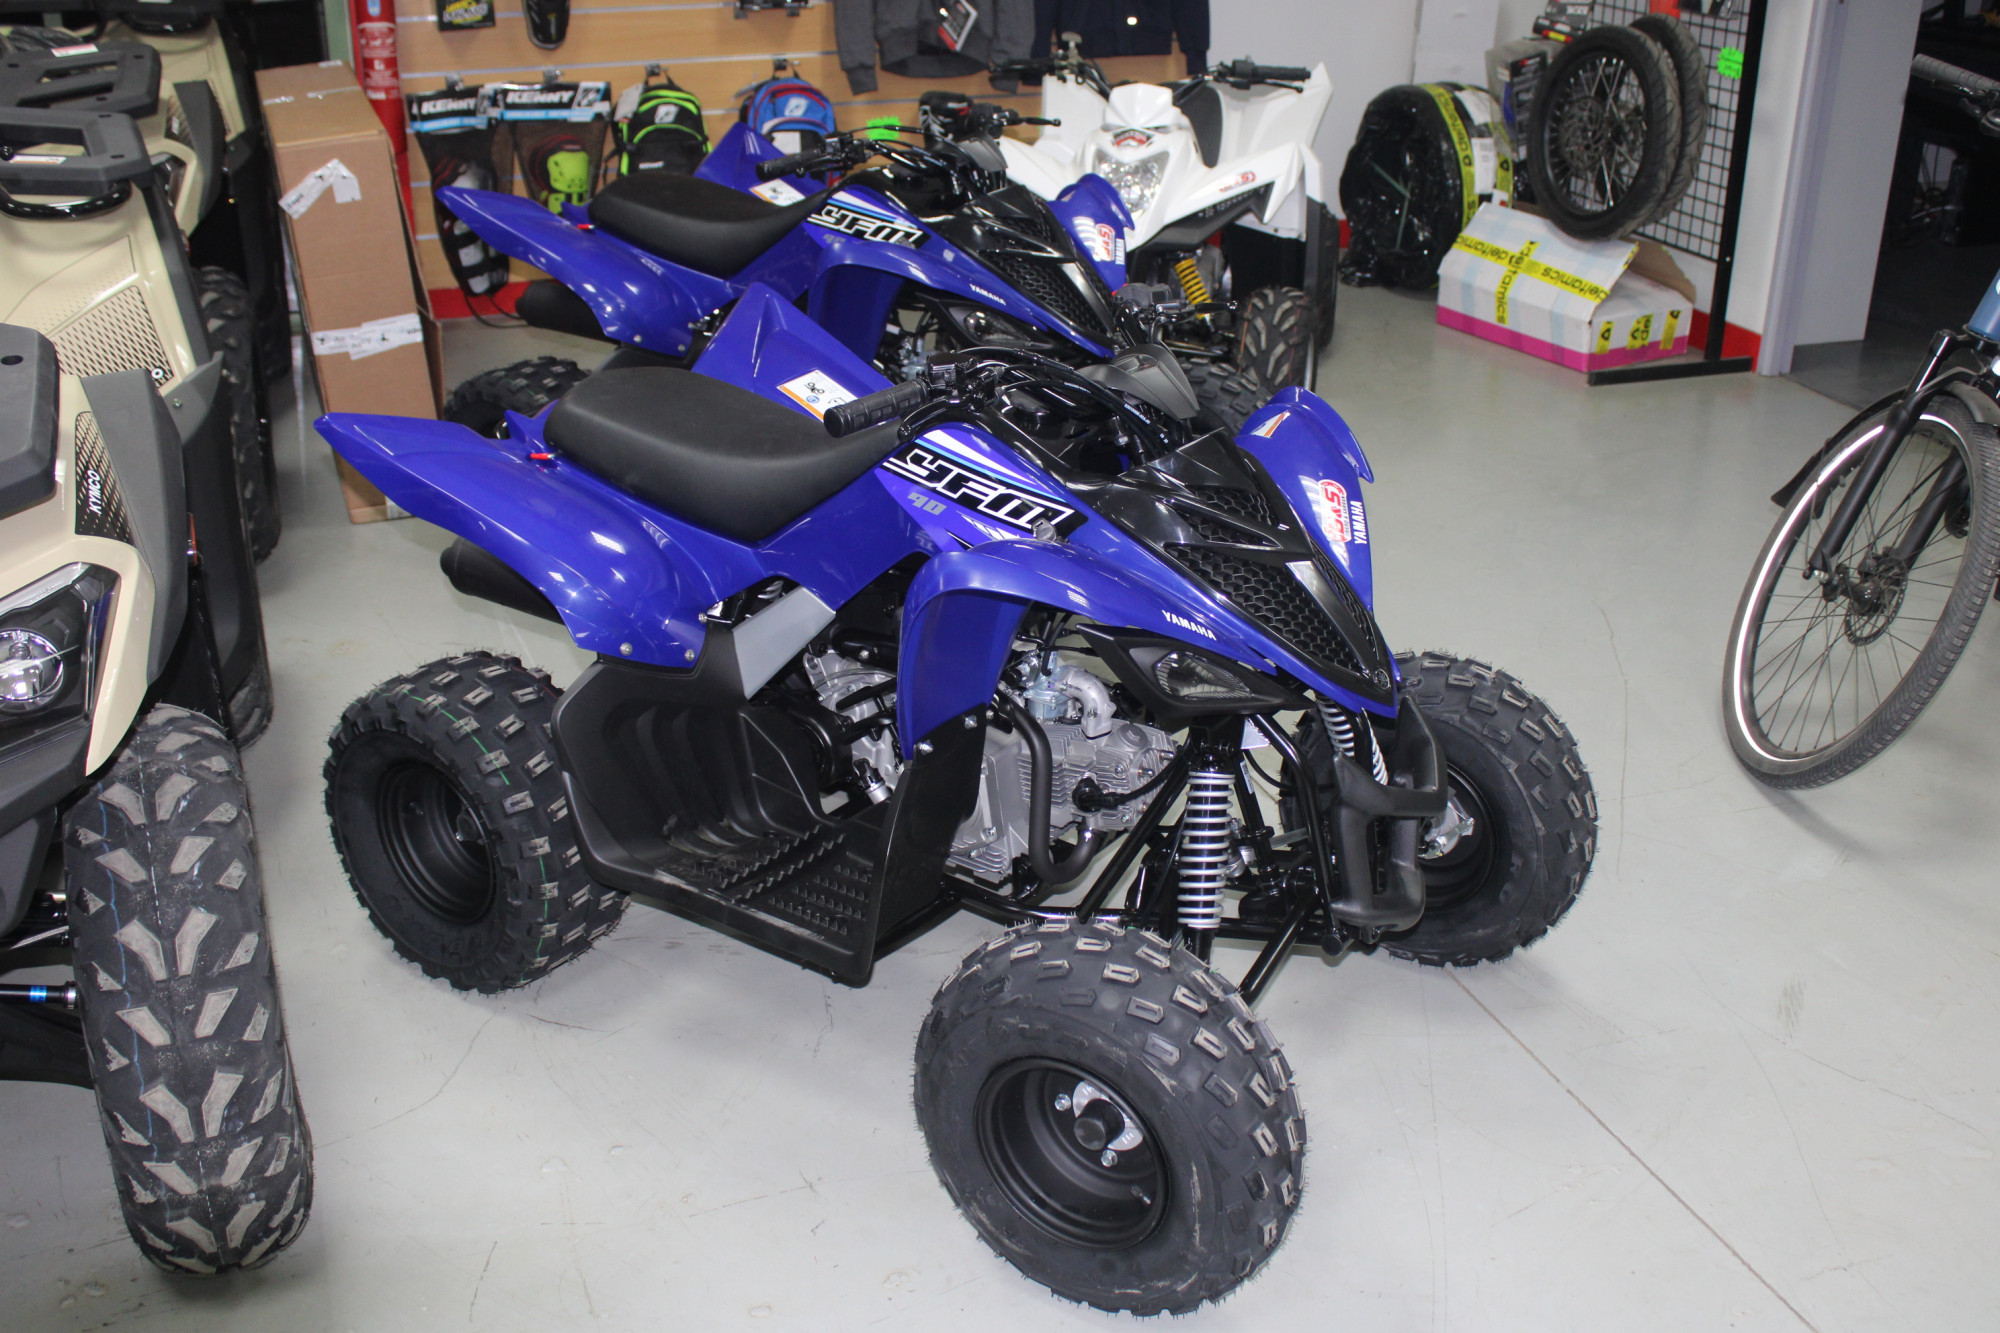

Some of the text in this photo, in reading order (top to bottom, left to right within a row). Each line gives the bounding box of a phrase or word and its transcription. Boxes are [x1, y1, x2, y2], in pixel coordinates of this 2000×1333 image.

[421, 97, 477, 115] KENNY
[506, 90, 575, 105] KENNY
[969, 283, 1006, 306] YAMAHA
[1541, 266, 1609, 301] deltamics
[87, 469, 102, 515] KYMCO
[907, 492, 948, 516] 90
[1350, 500, 1367, 544] YAMAHA
[1161, 610, 1217, 641] YAMAHA
